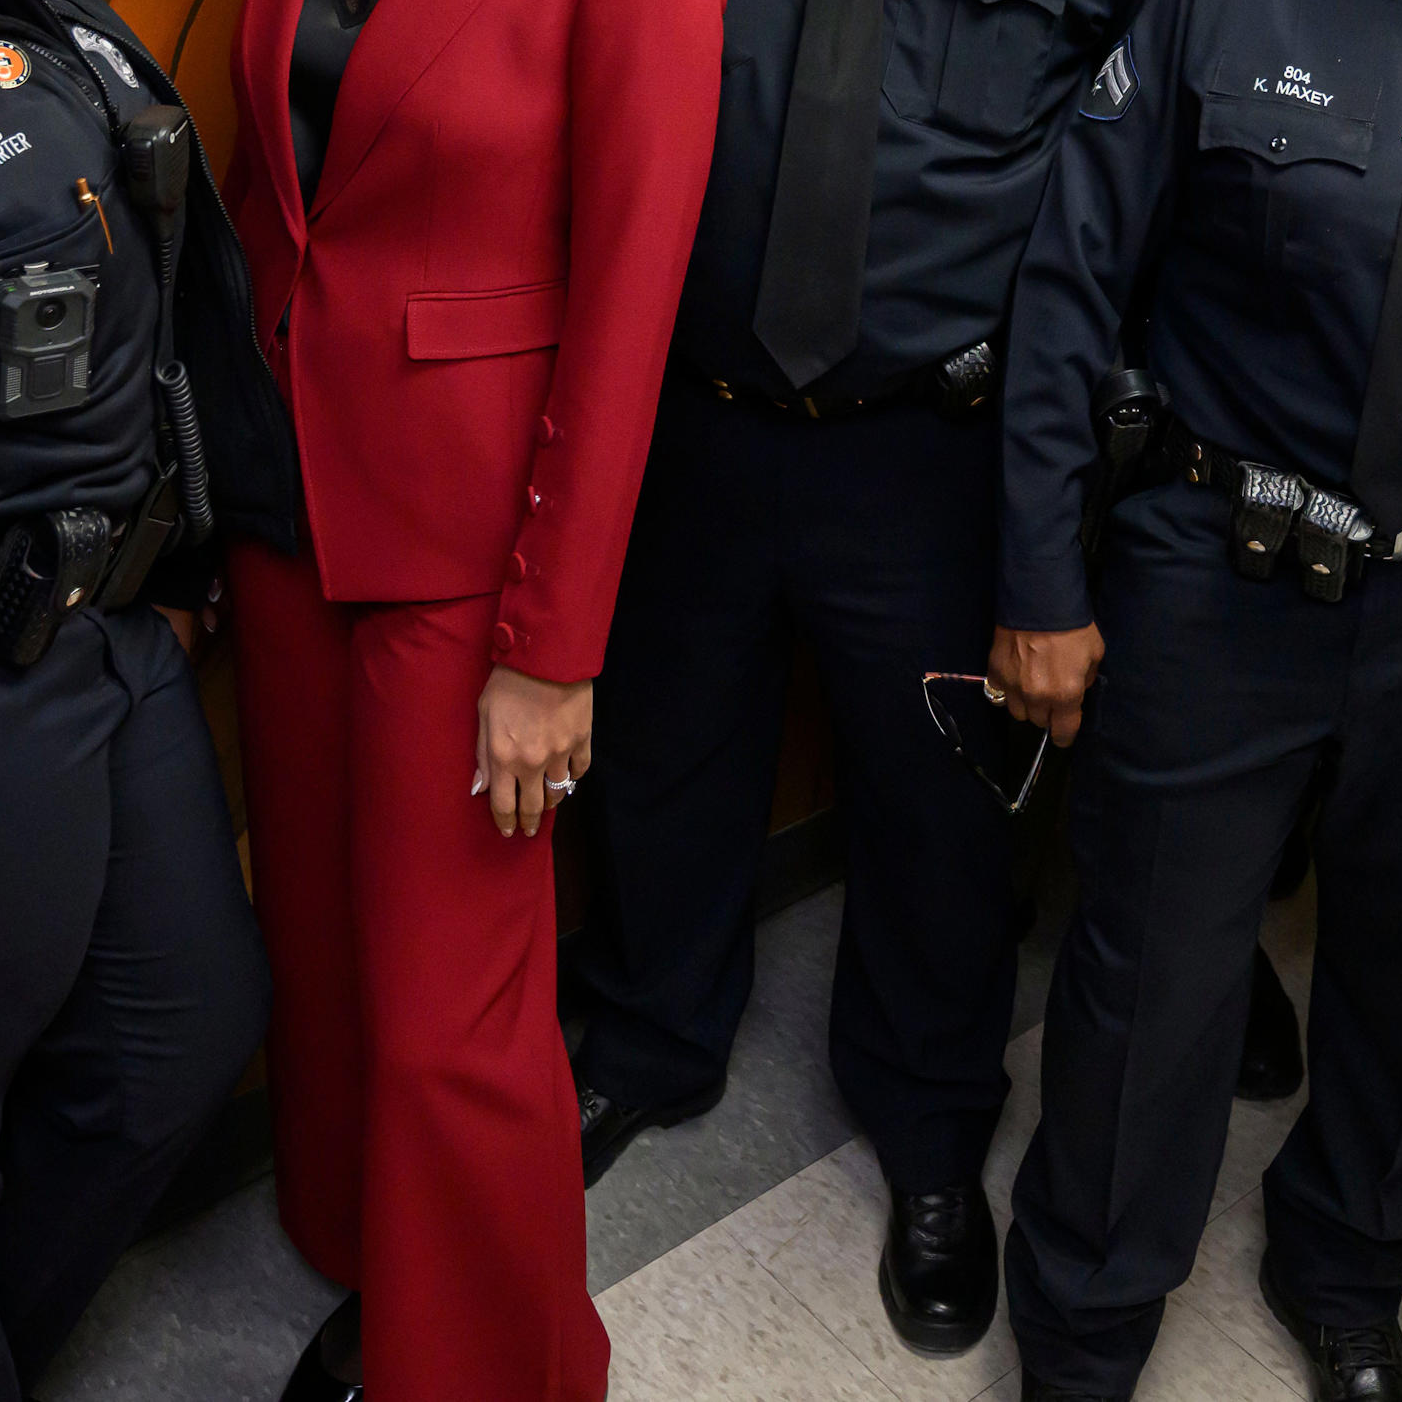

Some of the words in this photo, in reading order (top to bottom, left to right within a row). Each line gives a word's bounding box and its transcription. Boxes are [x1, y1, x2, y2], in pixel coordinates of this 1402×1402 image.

[1283, 65, 1311, 85] 804
[1253, 77, 1268, 93] K.
[1275, 80, 1334, 108] MAXEY
